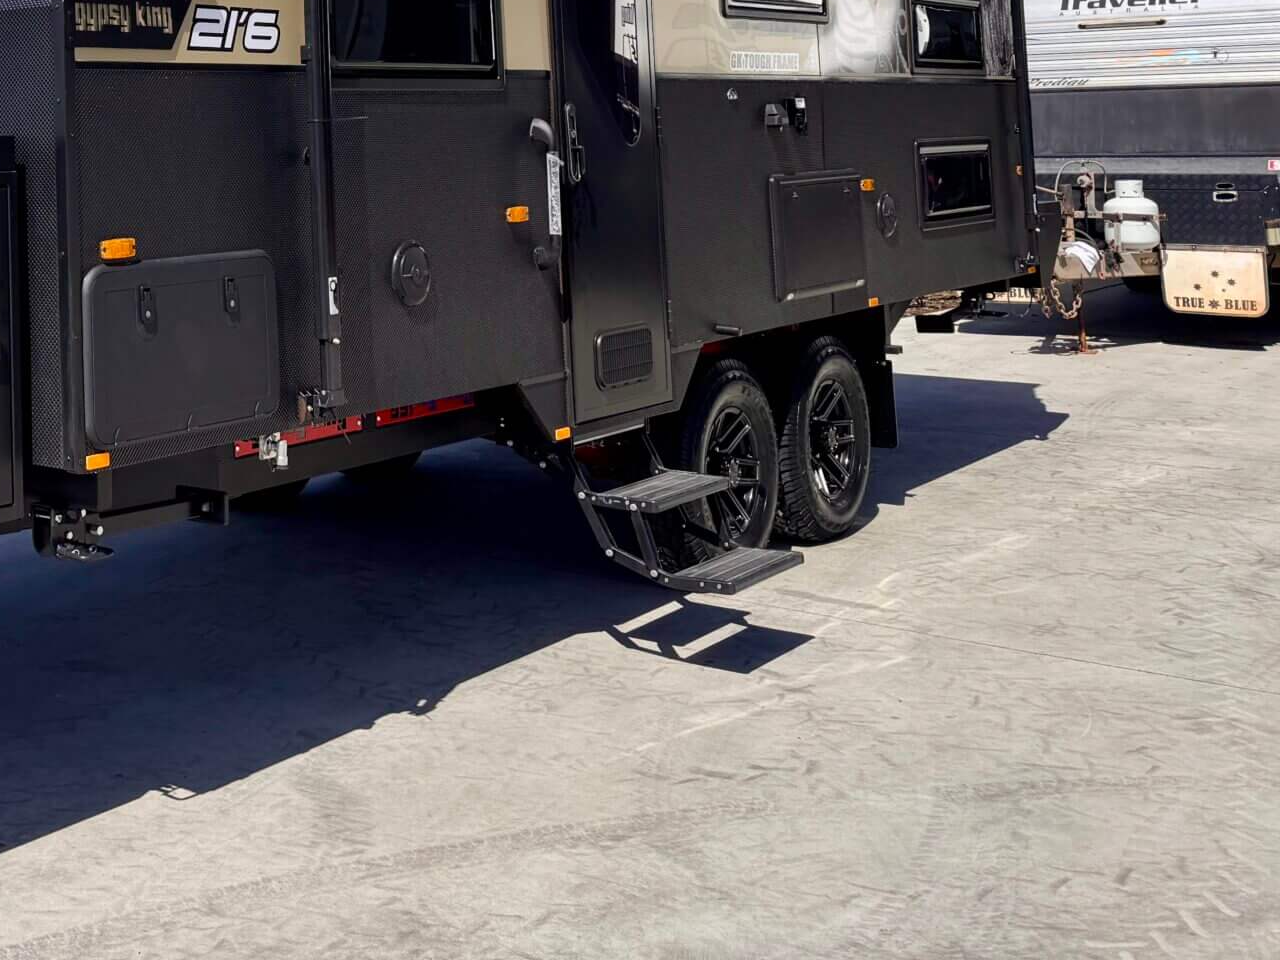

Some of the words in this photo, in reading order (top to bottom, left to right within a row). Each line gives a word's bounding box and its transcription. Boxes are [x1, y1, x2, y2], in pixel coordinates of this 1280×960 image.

[74, 1, 131, 33] gypsy
[135, 0, 174, 33] king
[1059, 4, 1199, 17] AUSTRALIA
[188, 6, 280, 53] 21'6
[1174, 296, 1205, 308] TRUE
[1224, 298, 1258, 311] BLUE
